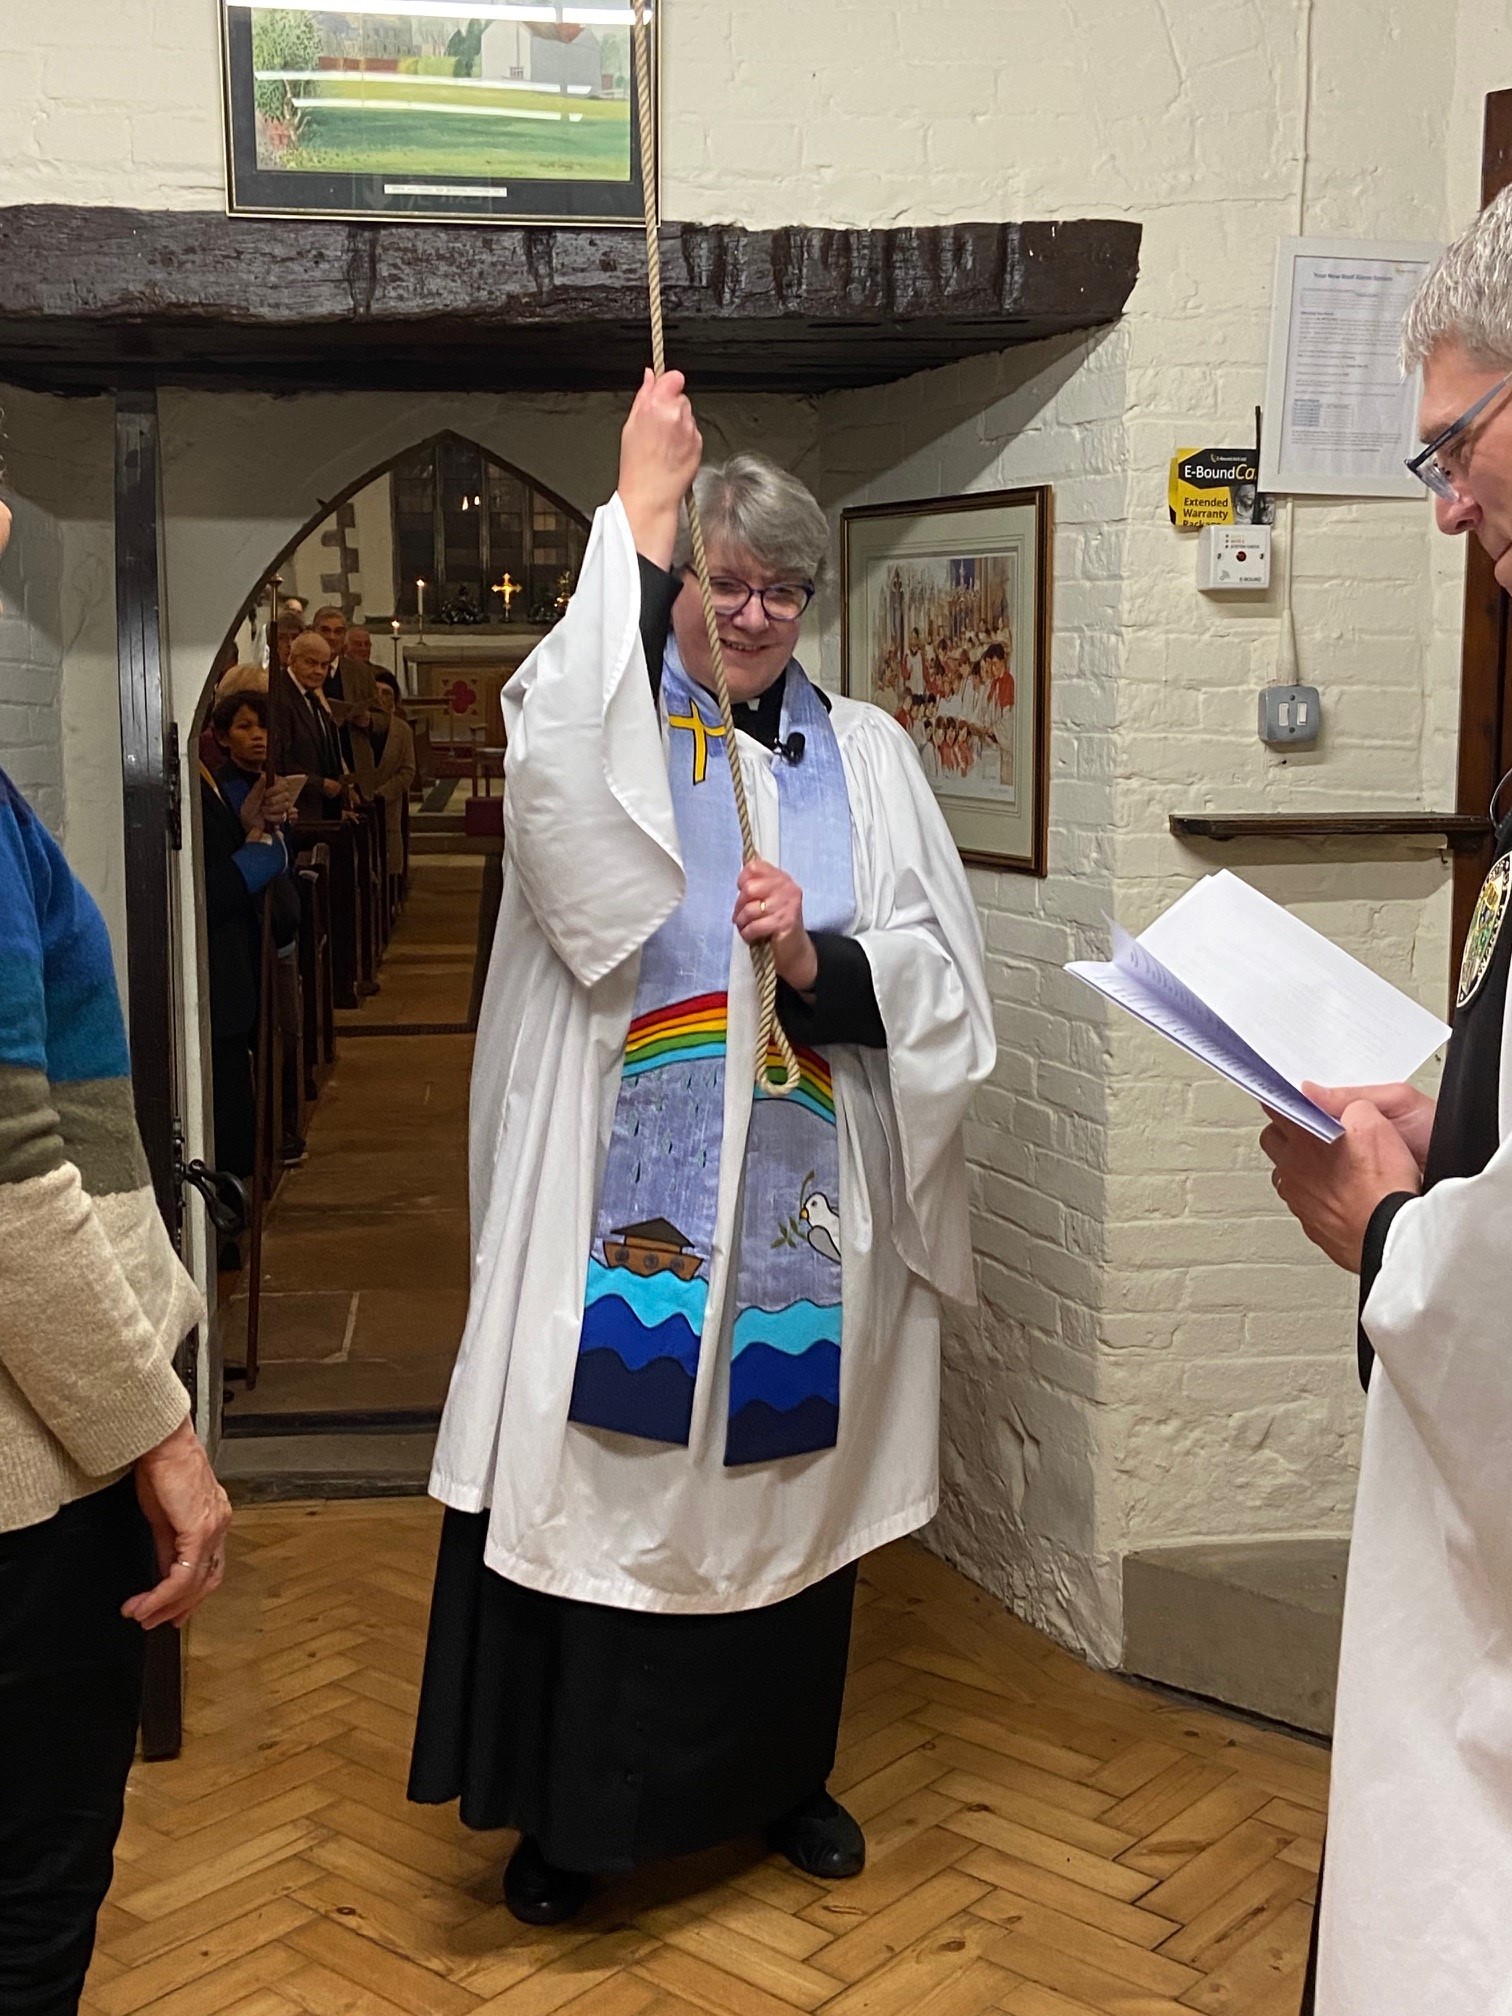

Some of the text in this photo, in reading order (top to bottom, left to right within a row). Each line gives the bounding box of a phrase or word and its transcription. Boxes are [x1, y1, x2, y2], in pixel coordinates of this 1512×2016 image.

[1184, 463, 1256, 480] E-BoundCa
[1184, 498, 1228, 507] Extended
[1183, 508, 1228, 521] Warranty
